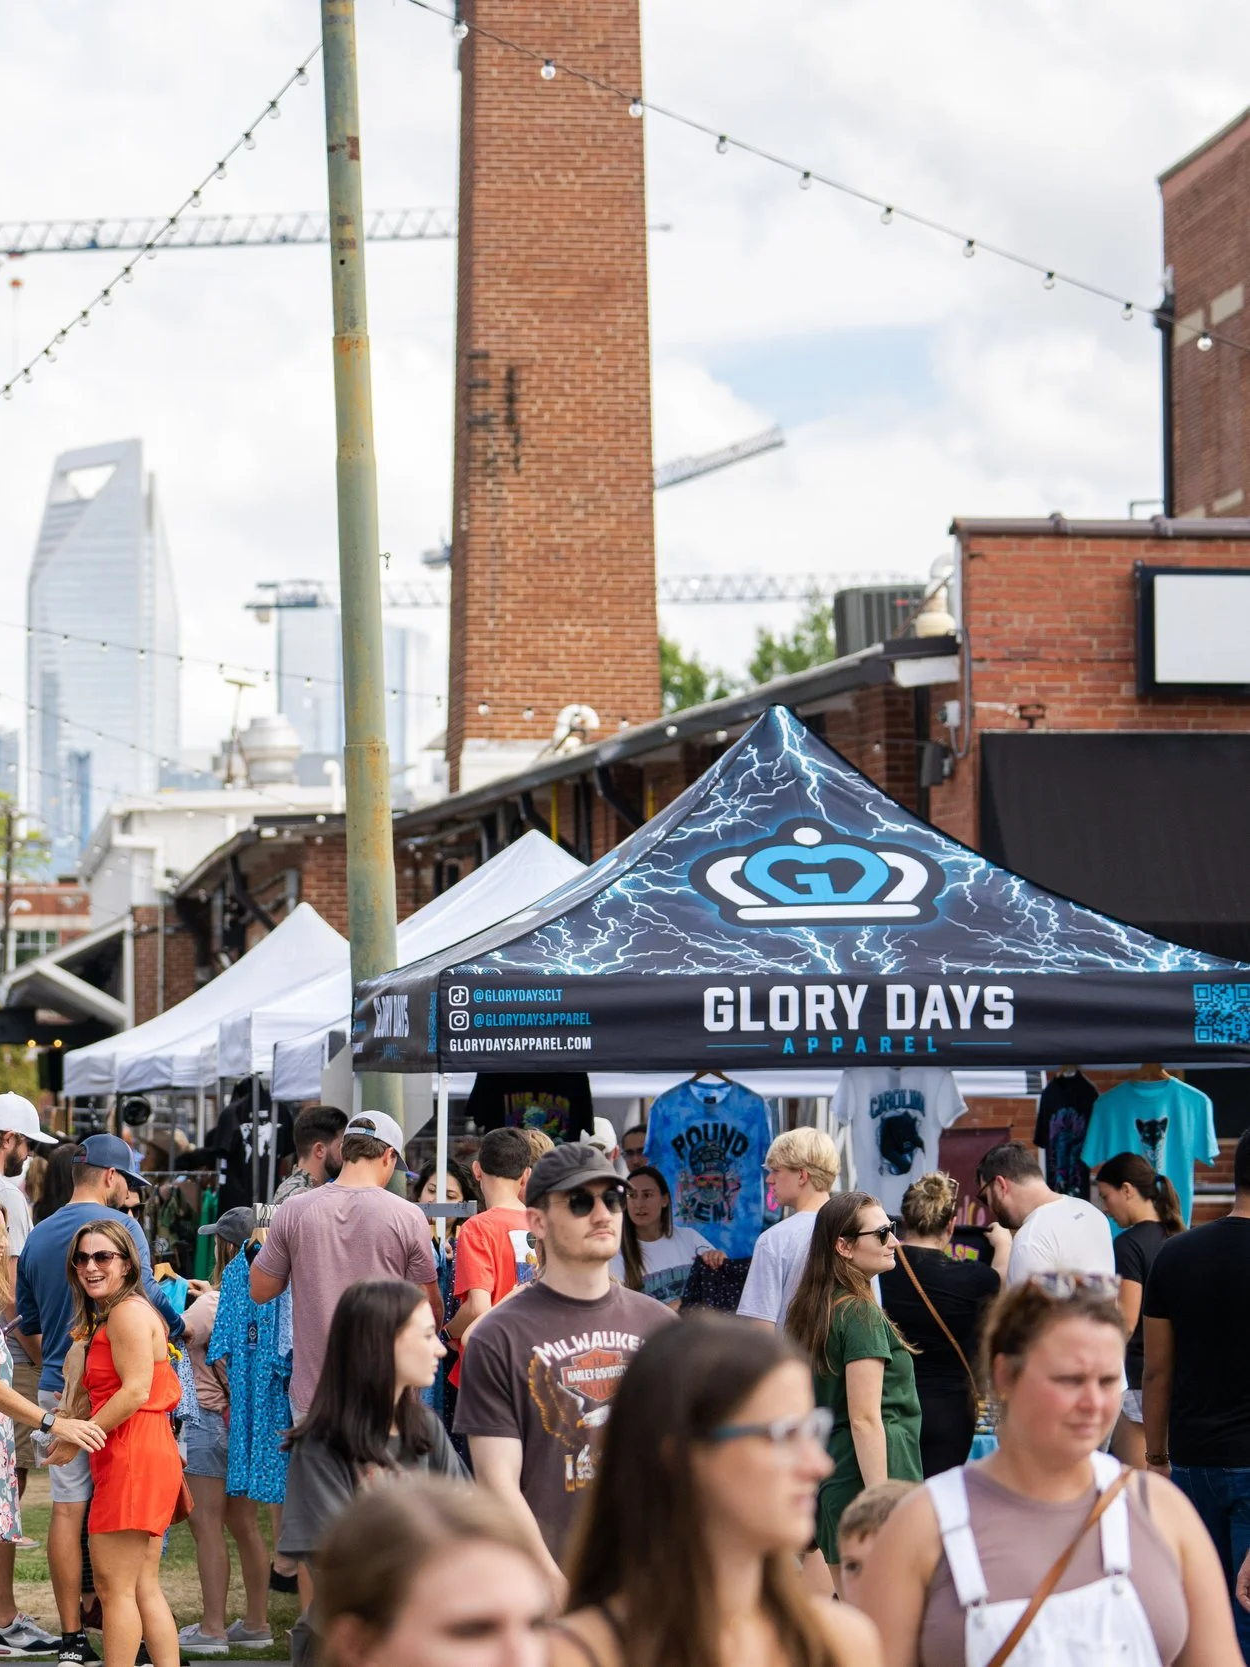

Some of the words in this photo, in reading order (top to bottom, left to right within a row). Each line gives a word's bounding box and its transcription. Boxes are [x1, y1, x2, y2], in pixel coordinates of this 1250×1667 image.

[473, 988, 563, 1003] @GLORYDAYSCLT
[703, 984, 869, 1032] GLORY
[886, 984, 1014, 1030] DAYS
[473, 1012, 592, 1028] @GLORYDAYSAPPAREL
[449, 1036, 592, 1052] GLORYDAYSAPPAREL.COM
[782, 1036, 938, 1054] APPAREL
[671, 1123, 749, 1160] POUND
[531, 1330, 646, 1368] MILWAUKE
[59, 1650, 83, 1660] adidas
